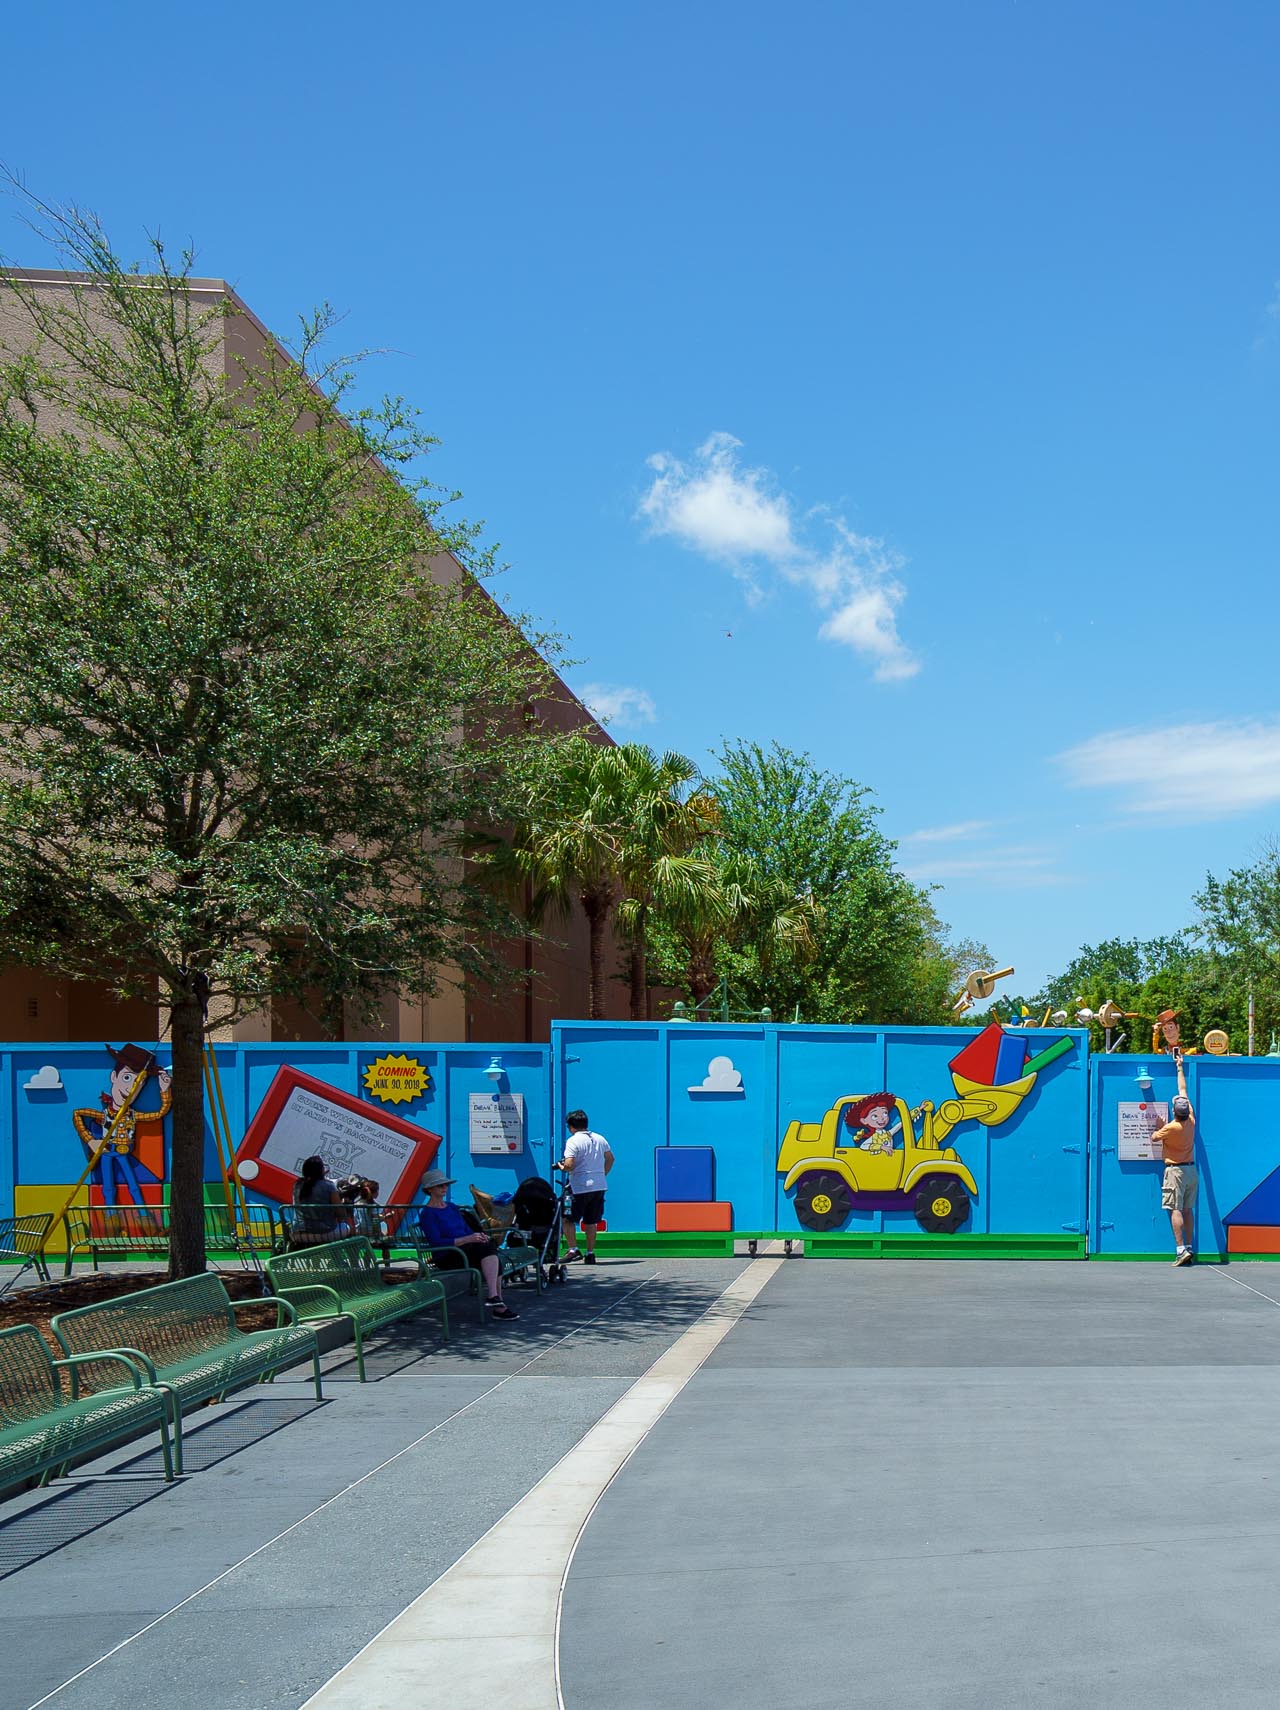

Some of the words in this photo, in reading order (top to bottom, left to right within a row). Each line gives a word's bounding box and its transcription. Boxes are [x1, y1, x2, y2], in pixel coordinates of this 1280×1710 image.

[377, 1066, 417, 1077] COMING
[373, 1079, 389, 1089] JUNE
[404, 1079, 420, 1089] 2018
[291, 1103, 303, 1113] IN
[296, 1094, 329, 1114] GUESS
[364, 1125, 410, 1150] PLAYING
[320, 1131, 367, 1164] TOY
